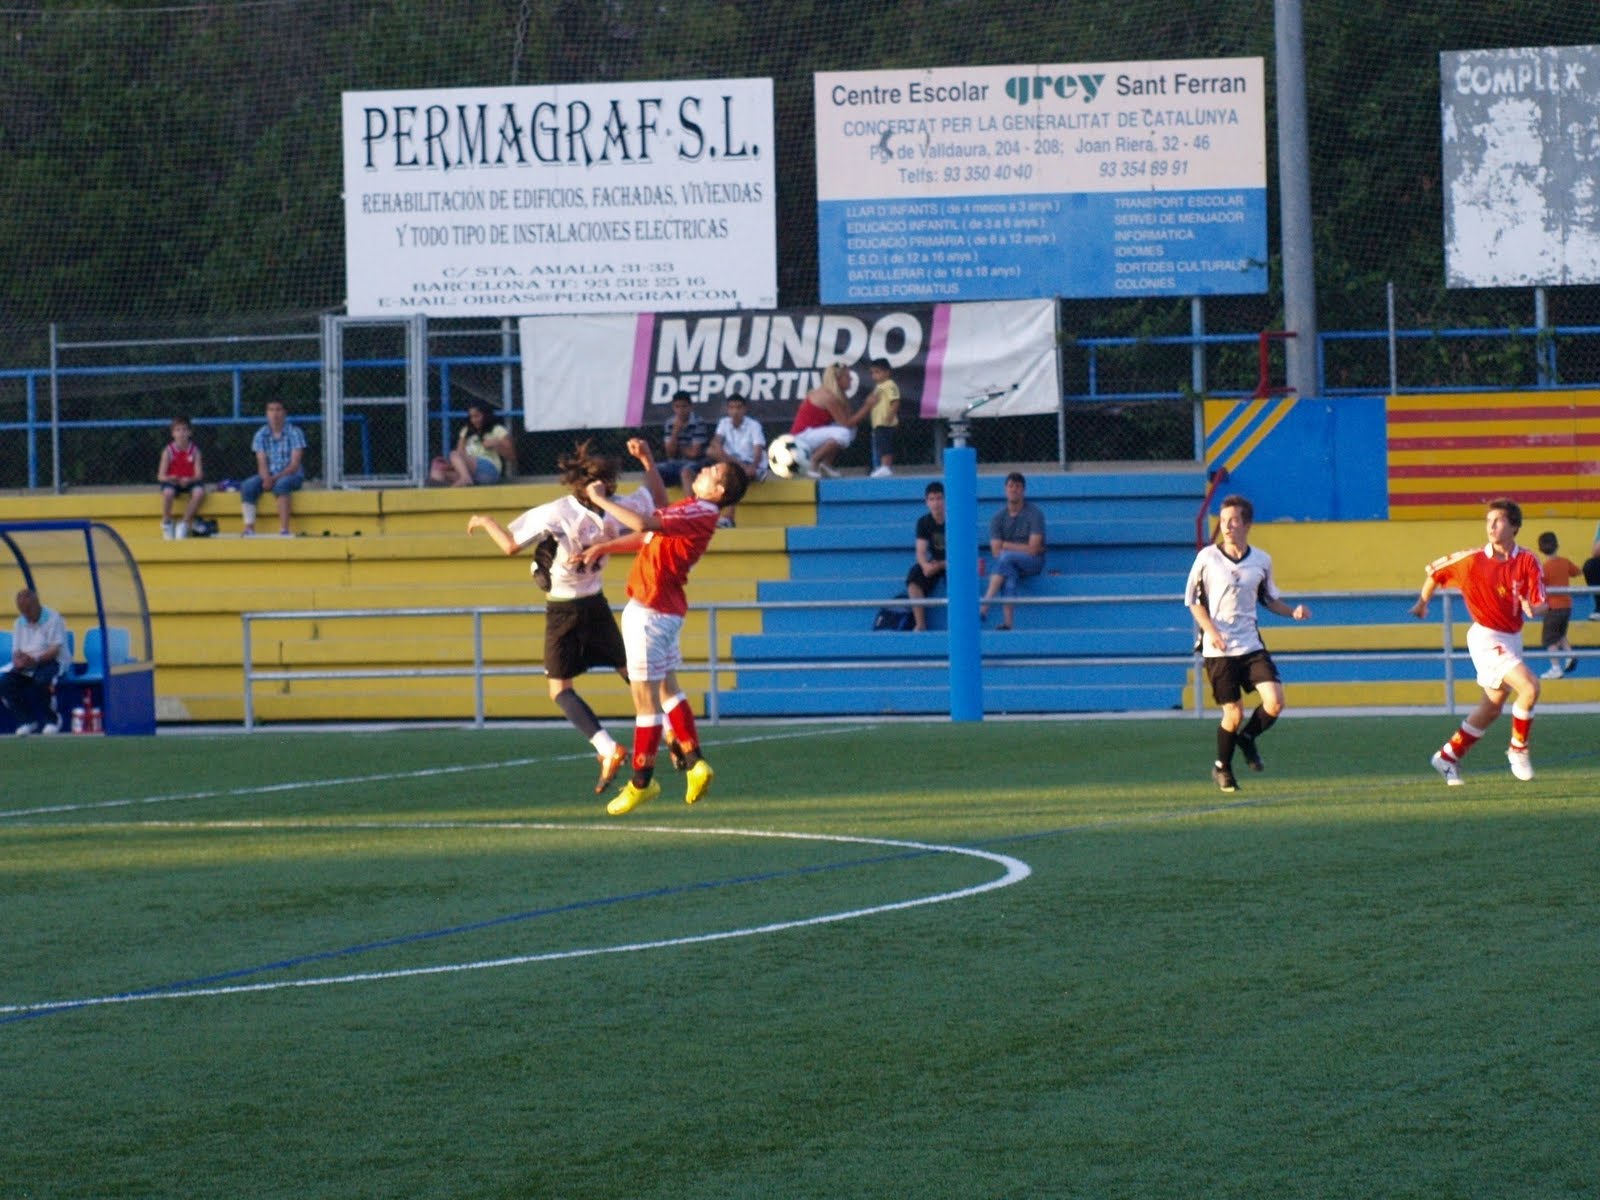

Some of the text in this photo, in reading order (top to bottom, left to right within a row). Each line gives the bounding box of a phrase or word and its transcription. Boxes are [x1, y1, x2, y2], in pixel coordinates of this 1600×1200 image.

[832, 73, 1246, 106] Centre Escolar grey Sant Ferran
[843, 109, 1239, 136] CONCERTAT PER LA GENERALITAT DE CATALUNYA
[362, 95, 760, 172] PERMAGRAF S.L.
[898, 144, 914, 159] de
[995, 141, 1020, 156] 204
[1075, 138, 1111, 154] Joan
[1162, 135, 1179, 150] 32
[1193, 134, 1210, 150] 46
[944, 167, 960, 182] 93
[965, 165, 990, 181] 350
[994, 165, 1011, 180] 40
[1015, 164, 1033, 180] 40
[1099, 161, 1117, 177] 93
[1120, 160, 1146, 176] 354
[1172, 159, 1188, 175] 91
[490, 190, 508, 209] DE
[682, 182, 762, 205] VIVIENDAS
[1115, 195, 1244, 208] TRANSPORT ESCOLAR
[1115, 211, 1244, 225] SERVEI DE MENJADOR
[396, 224, 407, 246] Y
[411, 226, 449, 246] TODO
[453, 224, 485, 245] TIPO
[490, 224, 508, 244] DE
[514, 221, 631, 243] INSTALACIONES
[1115, 245, 1164, 257] IDIOMES
[530, 264, 614, 276] AMALIA
[1115, 261, 1175, 273] SORTIDES
[413, 280, 540, 292] BARCELONA
[1115, 277, 1176, 289] COLONIES
[656, 312, 923, 374] MUNDO
